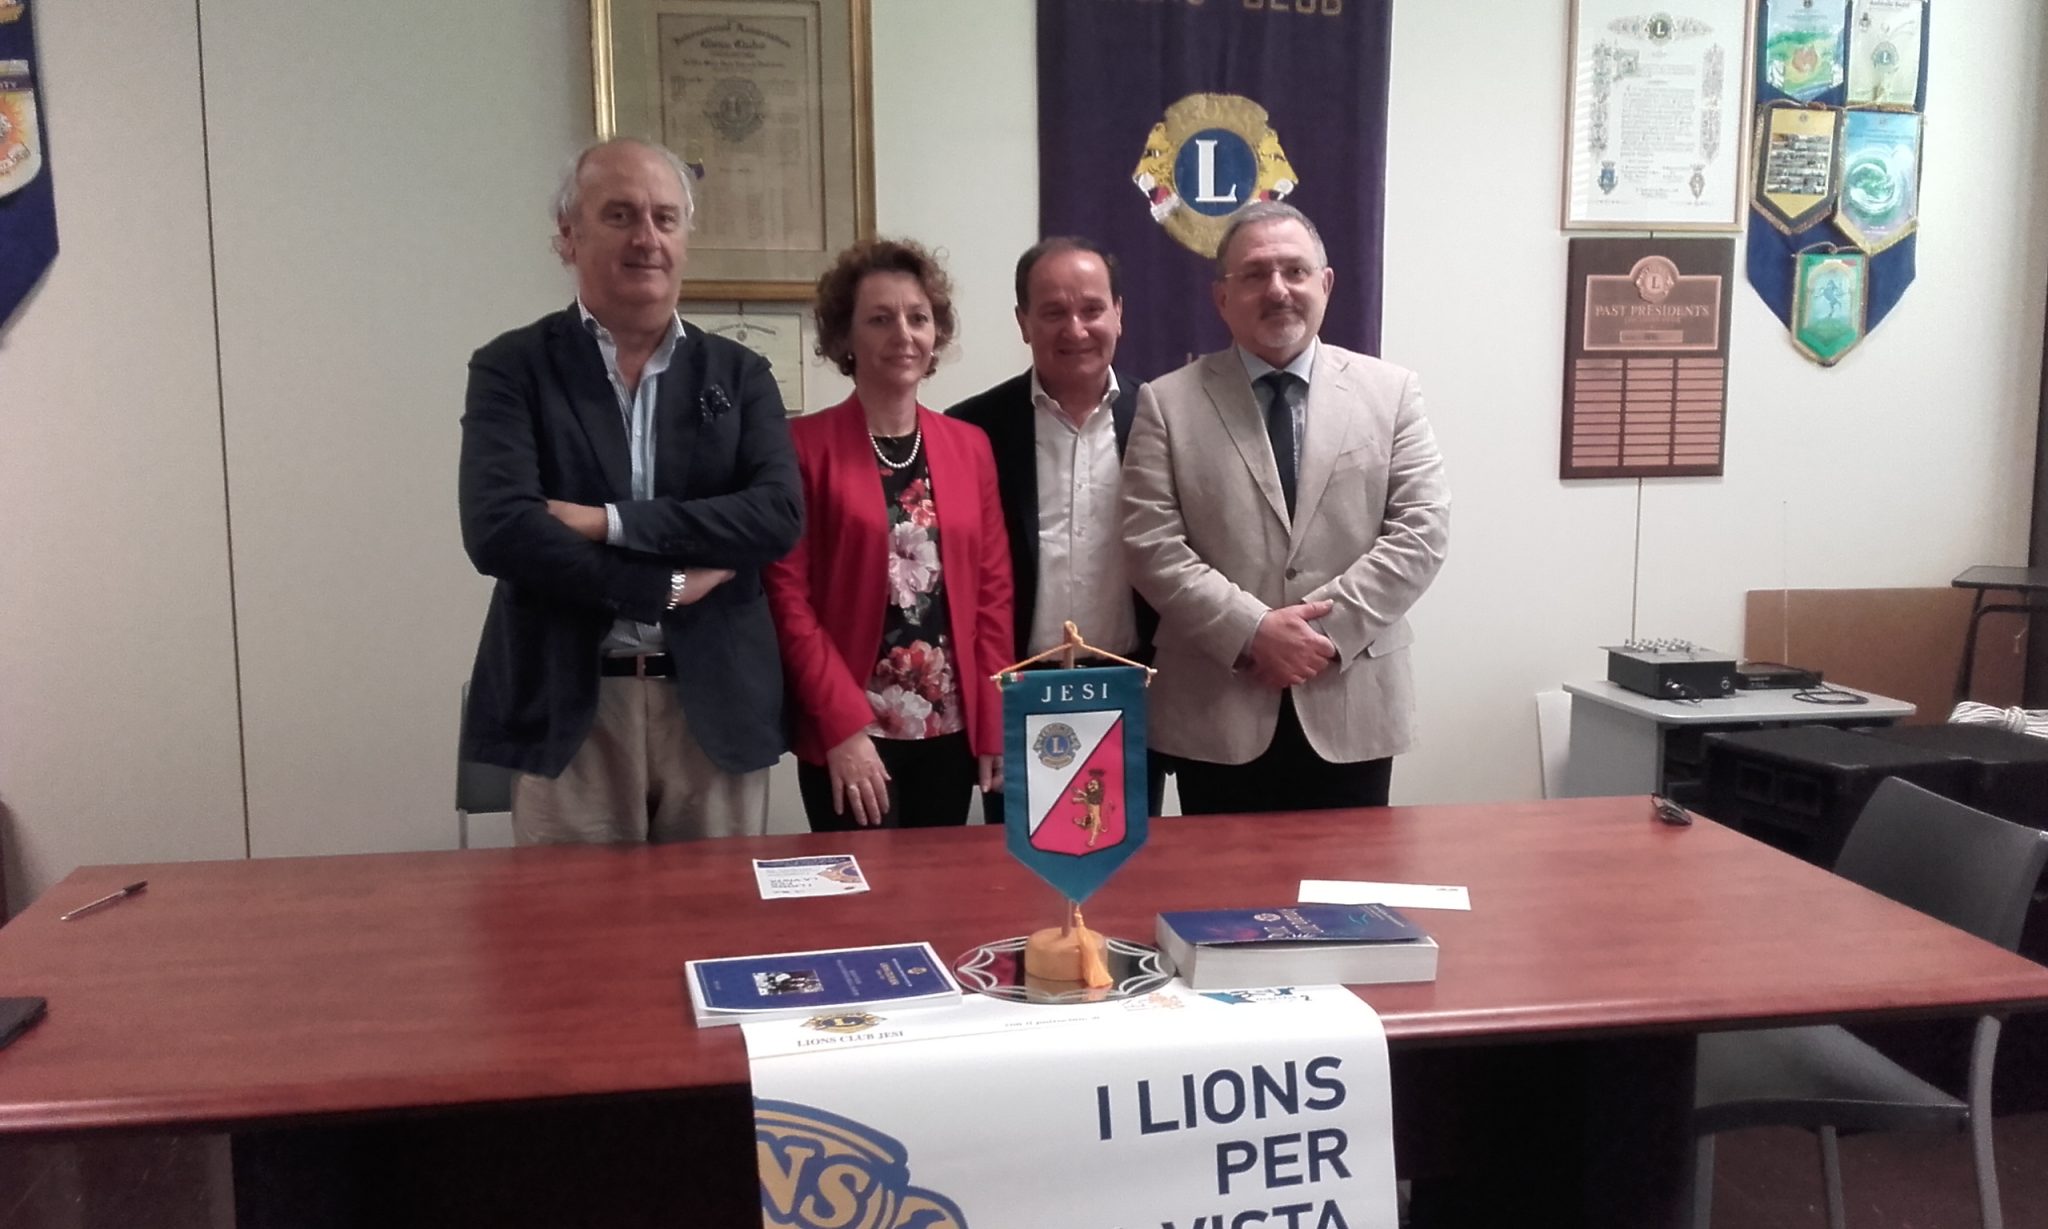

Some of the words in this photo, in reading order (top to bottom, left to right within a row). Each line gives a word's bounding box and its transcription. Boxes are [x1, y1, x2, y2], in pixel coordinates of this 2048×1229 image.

[1195, 139, 1238, 202] L
[1595, 304, 1627, 317] PAST
[1631, 304, 1711, 317] PRESIDENTS
[1041, 682, 1108, 703] JESI
[1052, 737, 1064, 753] L
[797, 1037, 837, 1047] LIONS
[839, 1033, 874, 1043] CLUB
[878, 1030, 904, 1039] JESI
[1097, 1085, 1112, 1141] I
[1137, 1056, 1346, 1135] LIONS
[1216, 1128, 1352, 1195] PER
